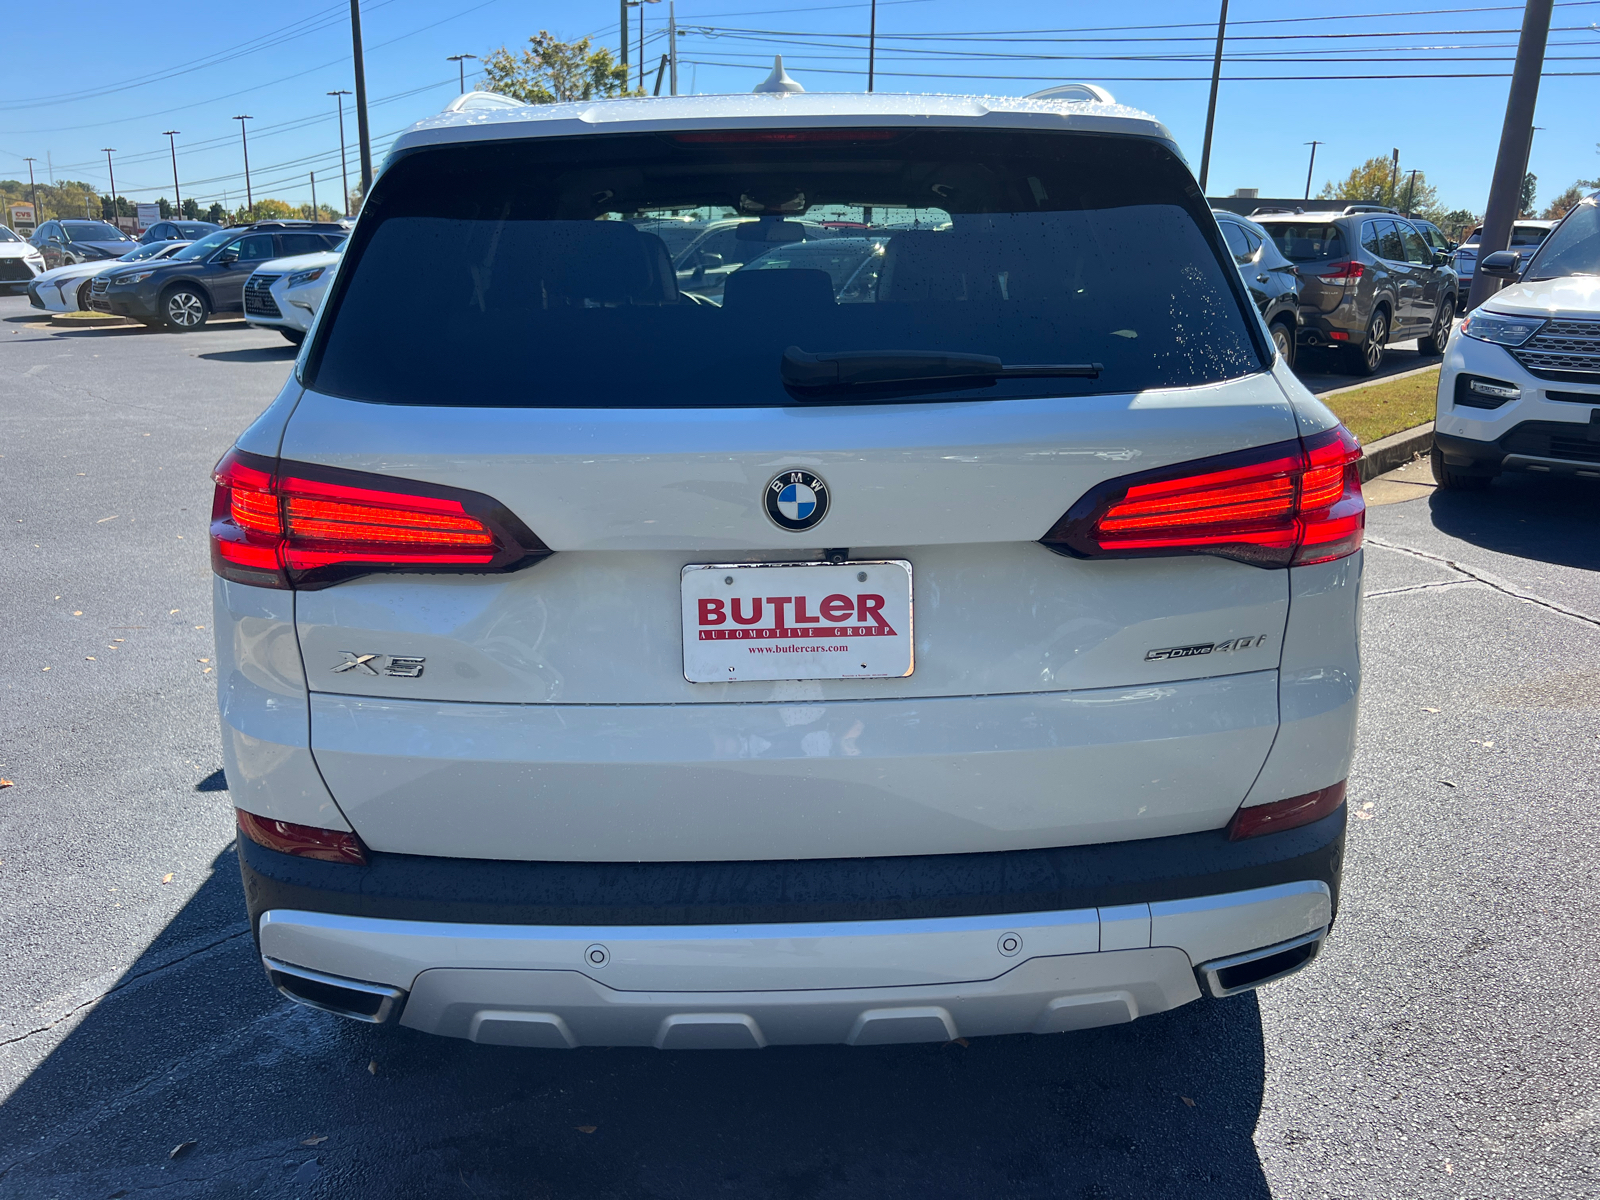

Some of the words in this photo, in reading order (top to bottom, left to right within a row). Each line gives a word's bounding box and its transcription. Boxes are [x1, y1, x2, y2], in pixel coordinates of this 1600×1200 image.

[771, 472, 824, 493] BMW
[700, 628, 815, 640] AUTOMOTIVE
[834, 626, 890, 636] GROUP
[748, 644, 849, 655] www.butlercars.com
[330, 650, 426, 678] X5
